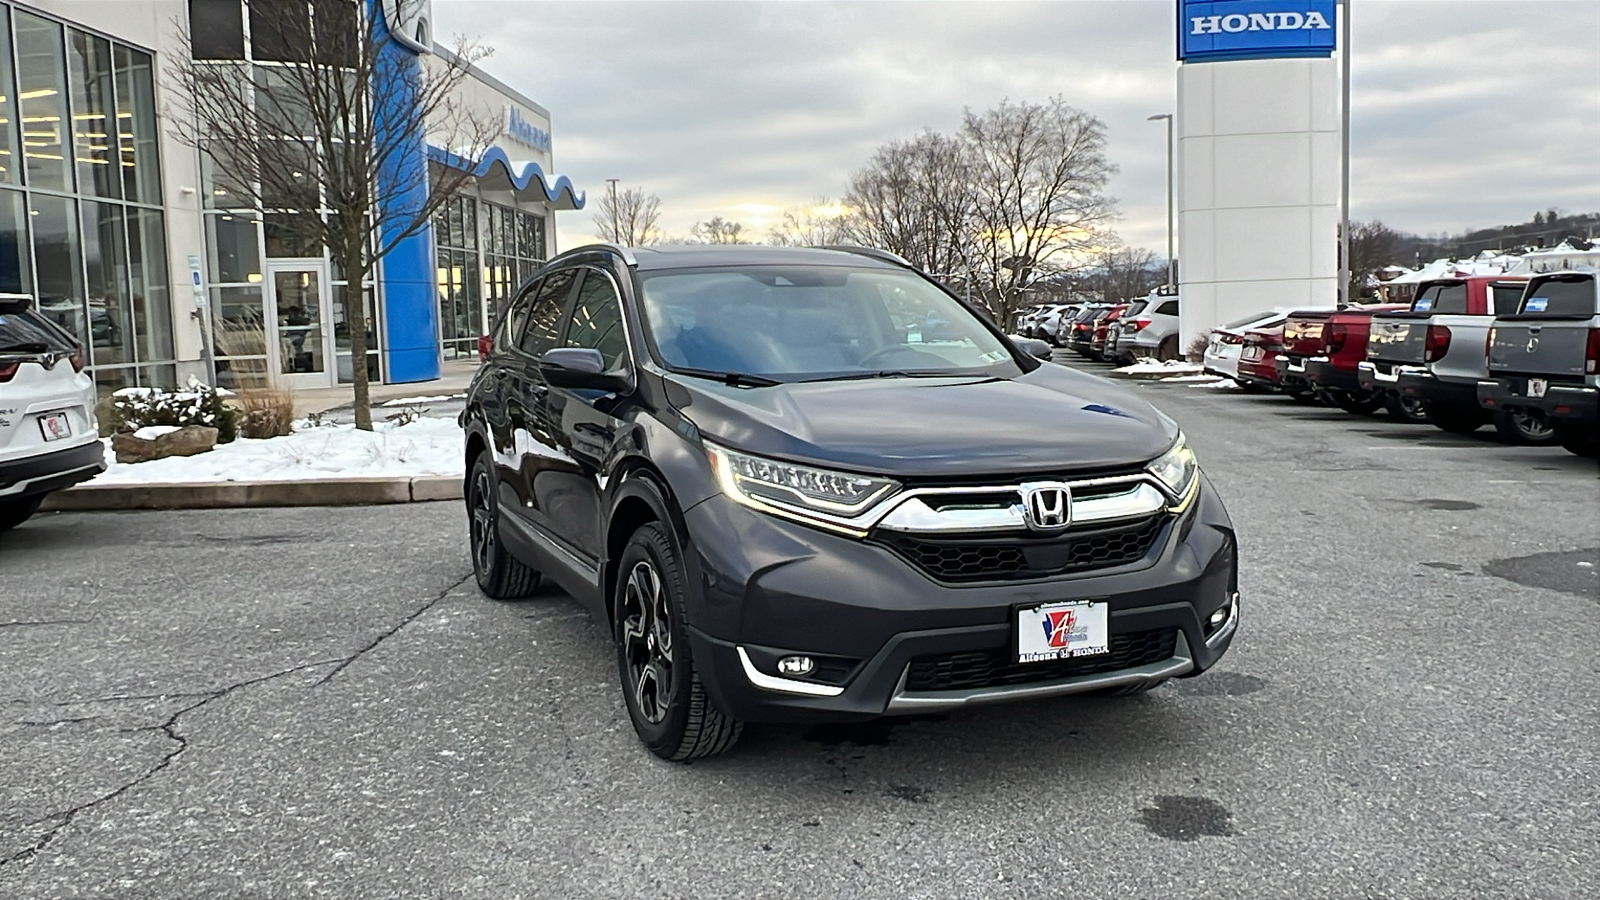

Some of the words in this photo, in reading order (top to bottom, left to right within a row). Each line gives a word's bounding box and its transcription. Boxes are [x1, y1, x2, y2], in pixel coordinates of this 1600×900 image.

[1191, 11, 1331, 34] HONDA
[1019, 652, 1057, 663] Altoona
[1073, 646, 1109, 657] HONDA
